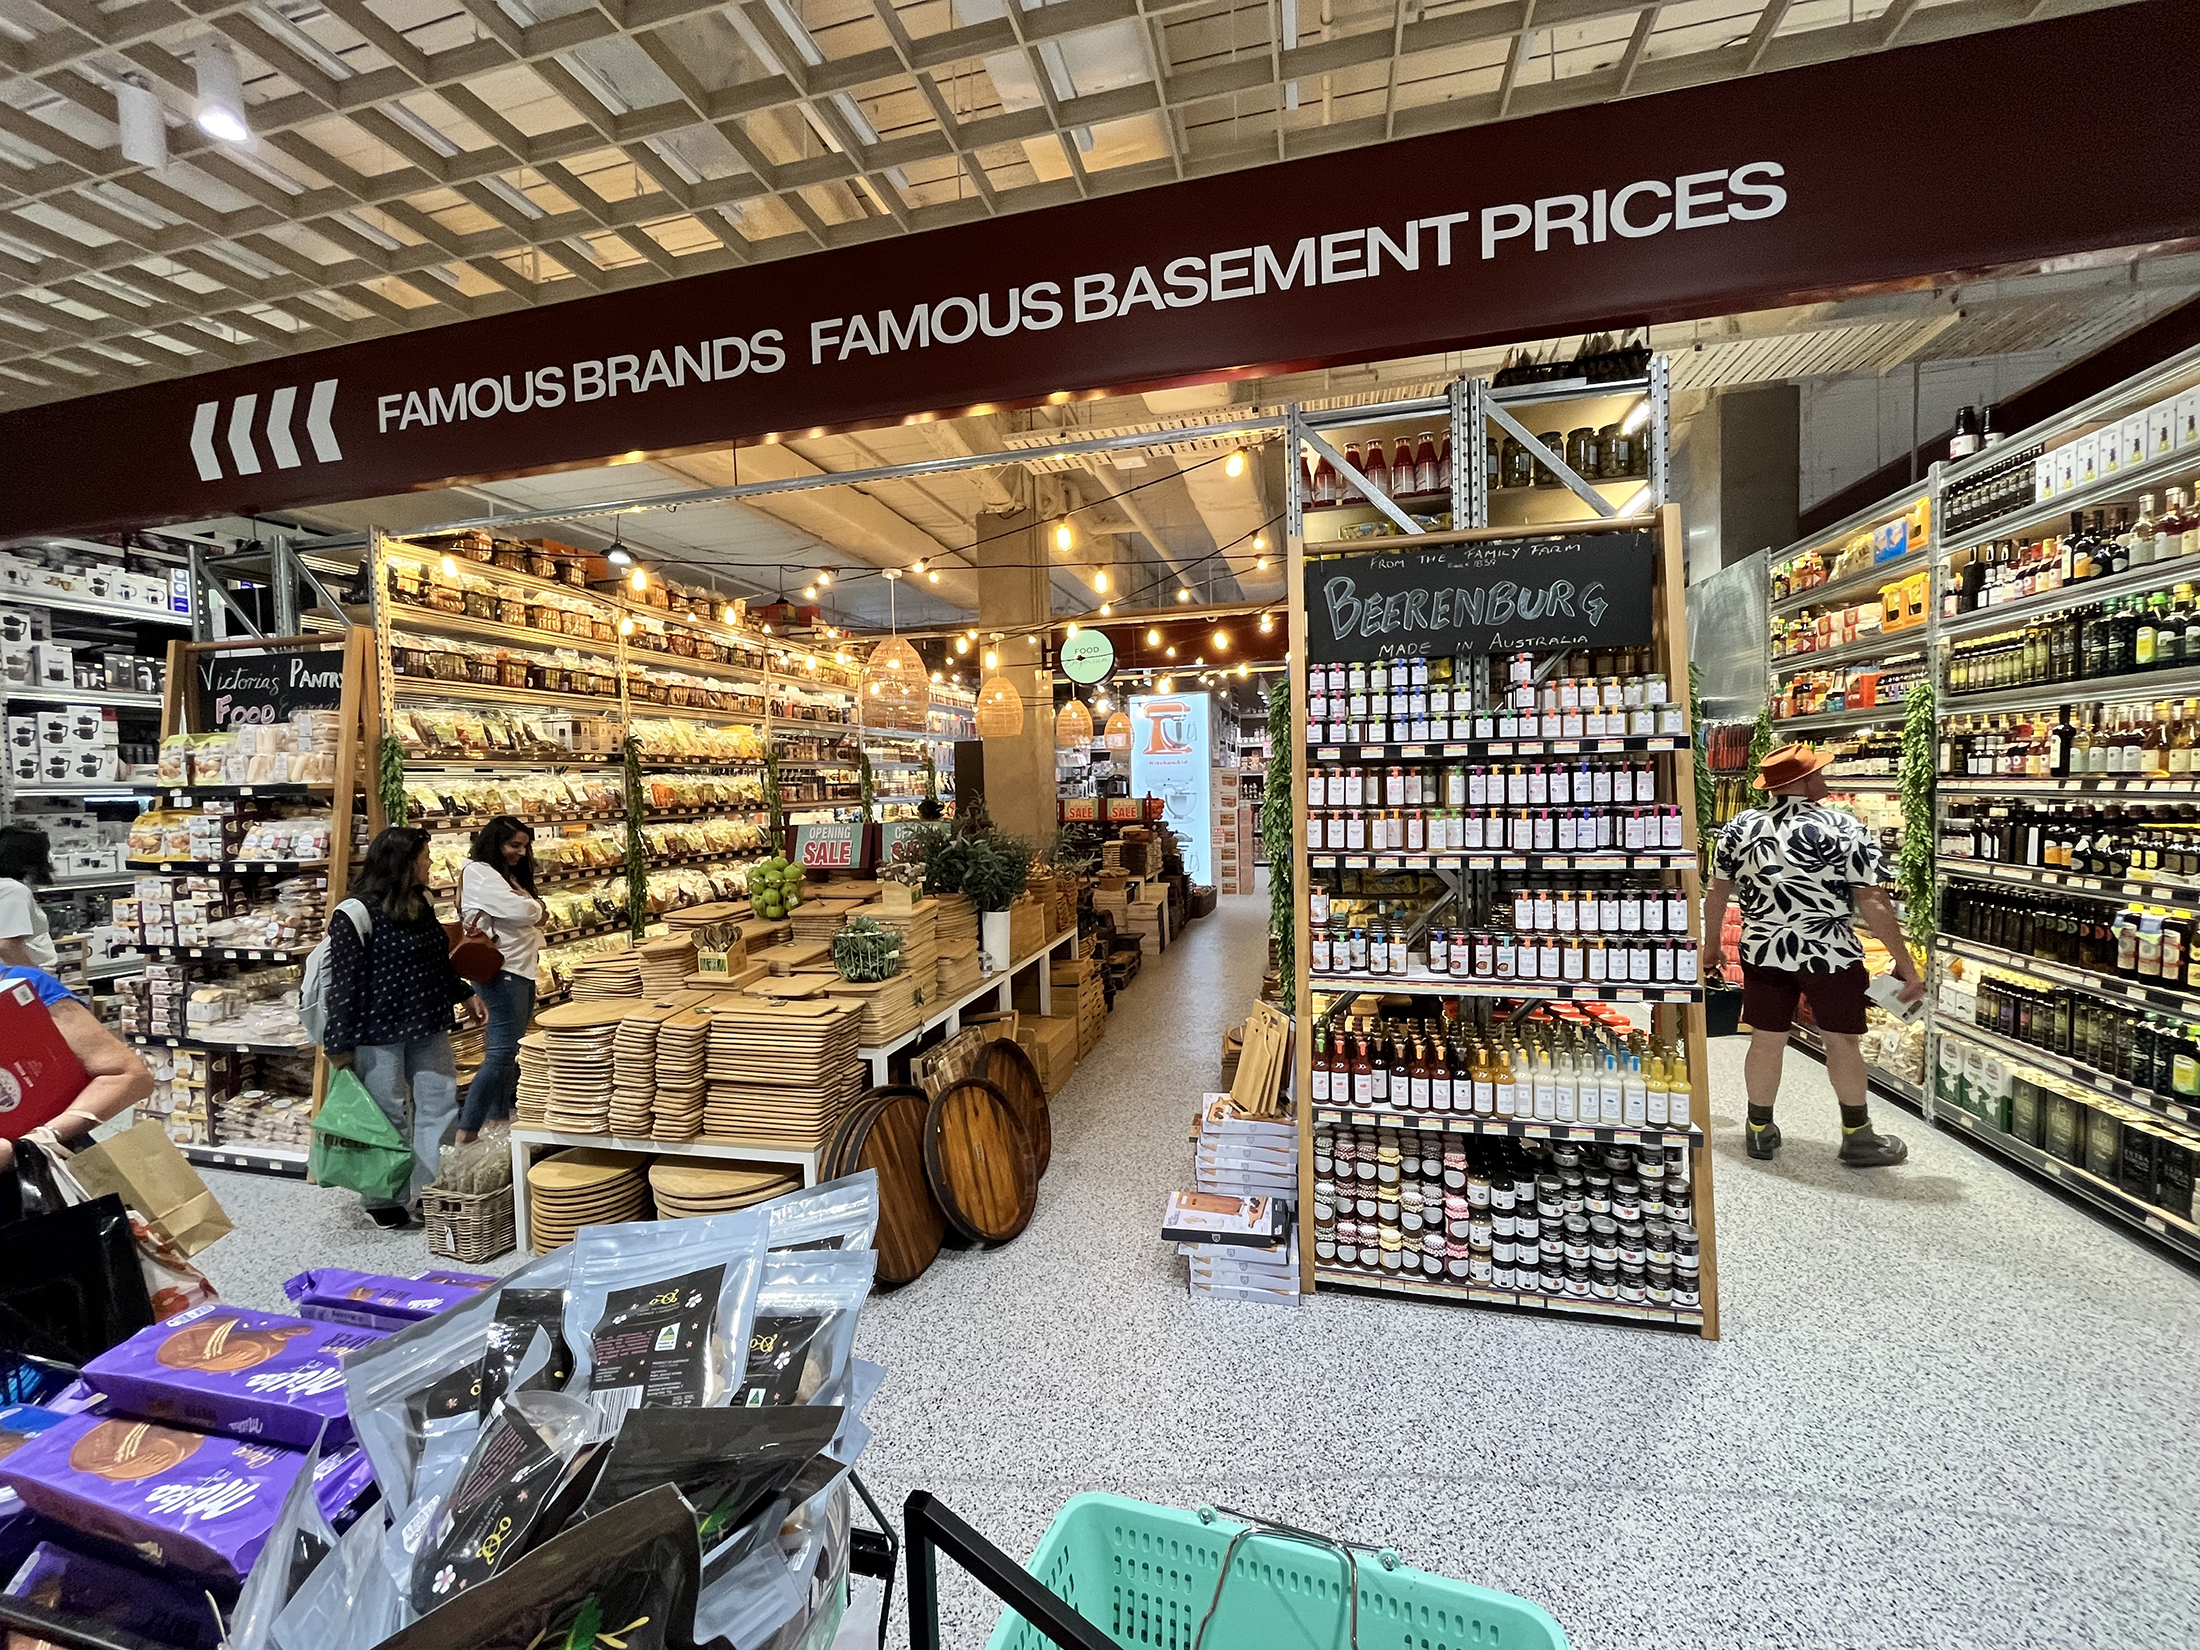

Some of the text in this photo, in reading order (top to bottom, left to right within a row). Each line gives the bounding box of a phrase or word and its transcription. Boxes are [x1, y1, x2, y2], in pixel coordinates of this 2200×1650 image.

[378, 161, 1788, 433] FAMOUS BRANDS FAMOUS BASEMENT PRICES
[1370, 544, 1581, 570] FROM THE FAMILY FARM
[1324, 576, 1609, 640] BEERENBURG
[1074, 646, 1100, 655] FOOD
[1378, 632, 1589, 657] MADE IN AUSTRALIA
[215, 694, 276, 725] FOOD
[1069, 806, 1093, 819] SALE
[1112, 806, 1137, 819] SALE
[809, 826, 851, 840] OPENING
[803, 840, 853, 865] SALE
[245, 1367, 348, 1396] Milka
[228, 1417, 263, 1434] Milka
[144, 1478, 260, 1520] Milka
